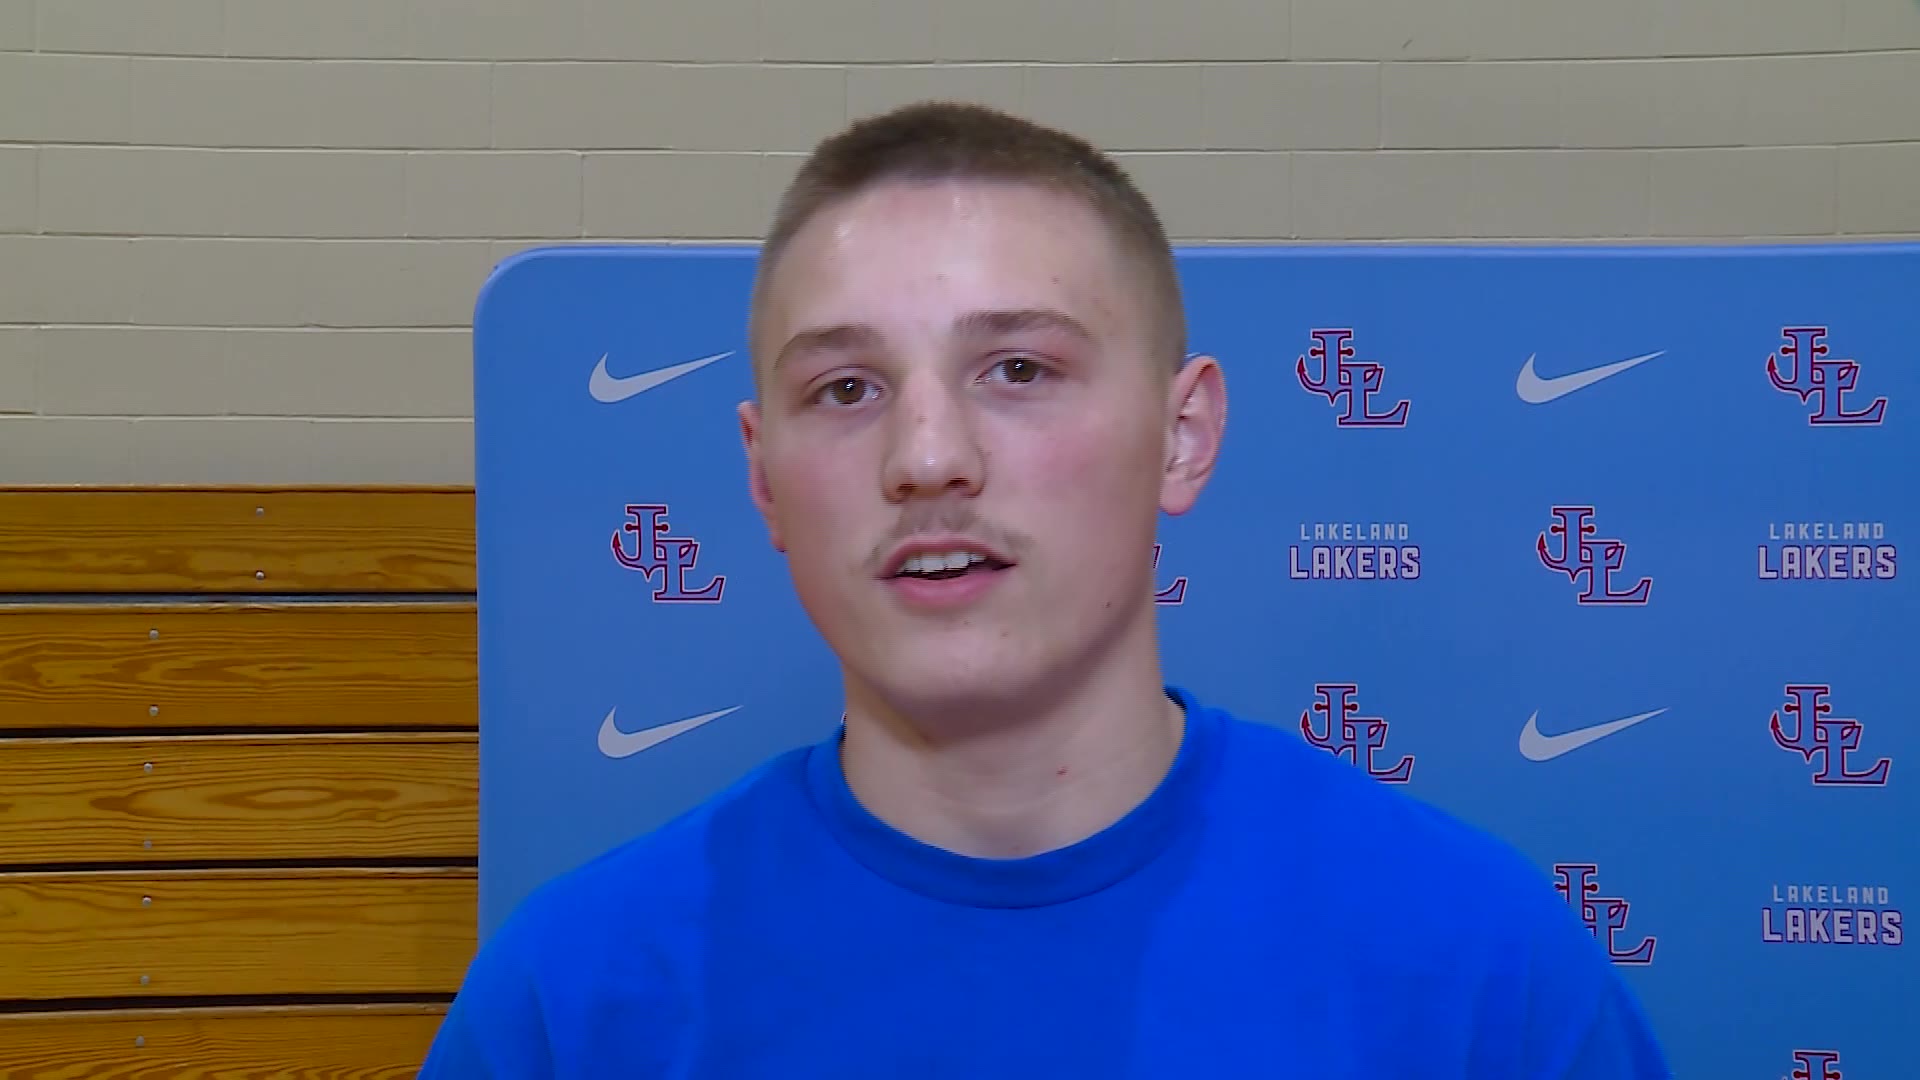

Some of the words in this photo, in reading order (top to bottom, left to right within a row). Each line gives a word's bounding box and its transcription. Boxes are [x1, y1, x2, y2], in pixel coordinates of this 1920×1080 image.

[1300, 523, 1410, 541] LAKELAND
[1769, 522, 1885, 541] LAKELAND
[1289, 545, 1421, 580] LAKERS
[1757, 545, 1897, 580] LAKERS
[1772, 883, 1890, 906] LAKELAND
[1761, 907, 1903, 946] LAKERS
